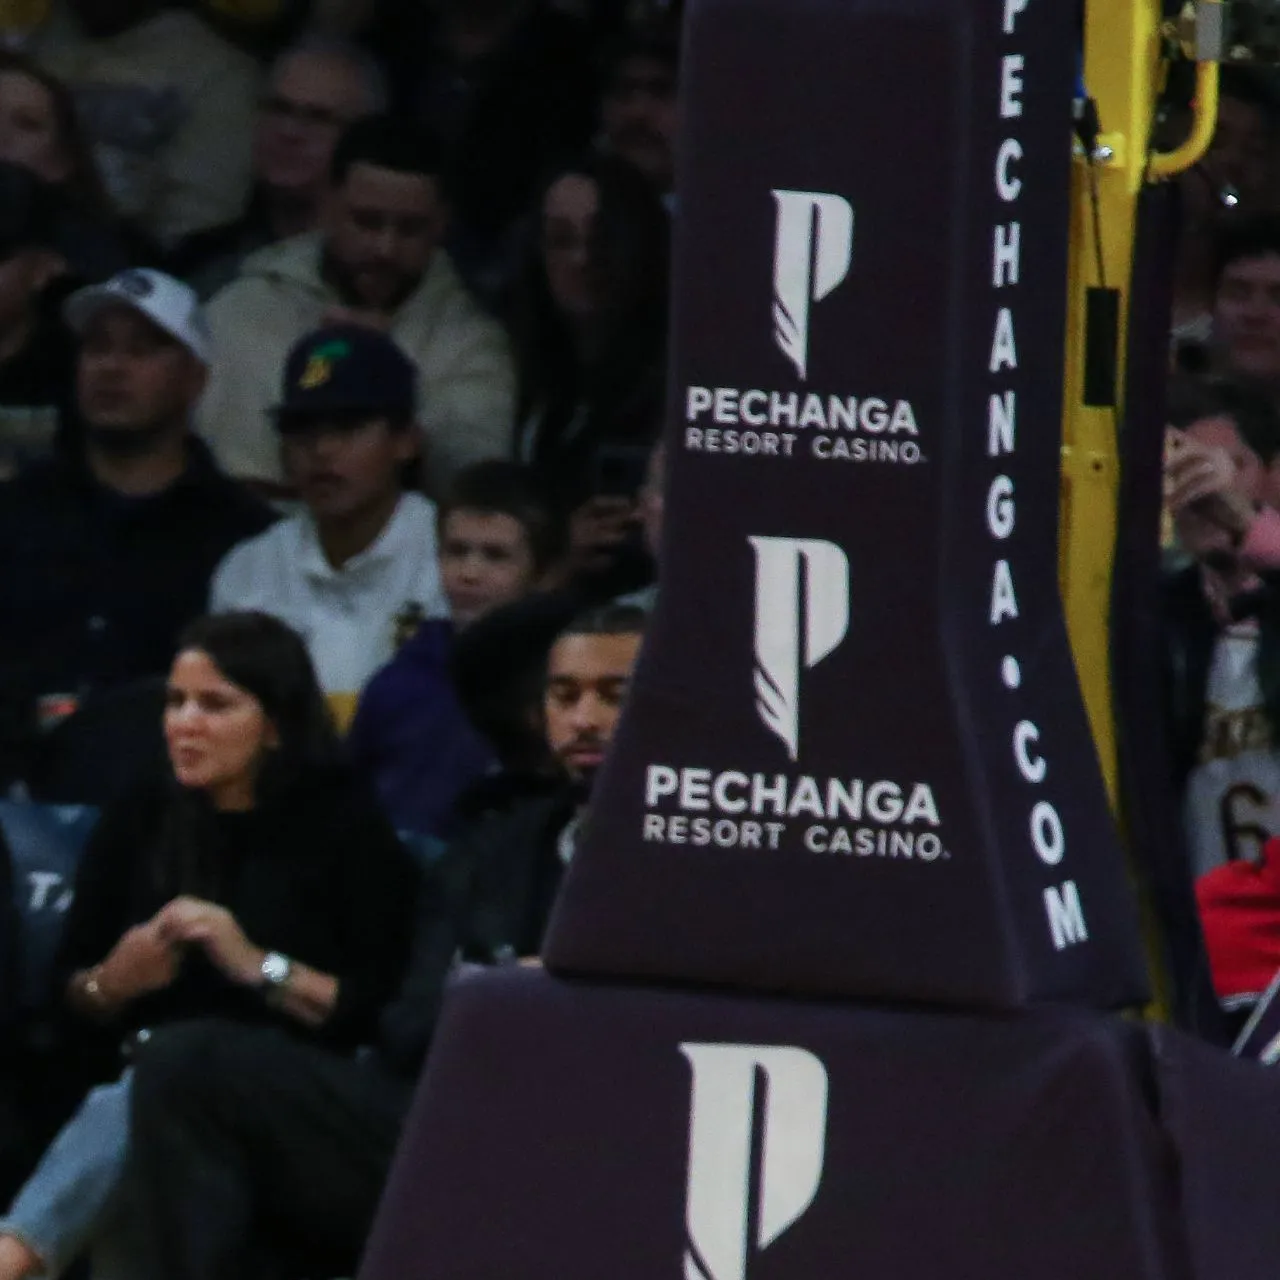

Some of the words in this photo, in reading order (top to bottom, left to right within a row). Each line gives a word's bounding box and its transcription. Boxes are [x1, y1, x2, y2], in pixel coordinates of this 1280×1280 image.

[686, 386, 919, 436] PECHANGA
[684, 427, 797, 456] RESORT
[811, 435, 921, 464] CASINO
[646, 764, 941, 825] PECHANGA
[643, 814, 786, 849] RESORT
[804, 824, 942, 861] CASINO
